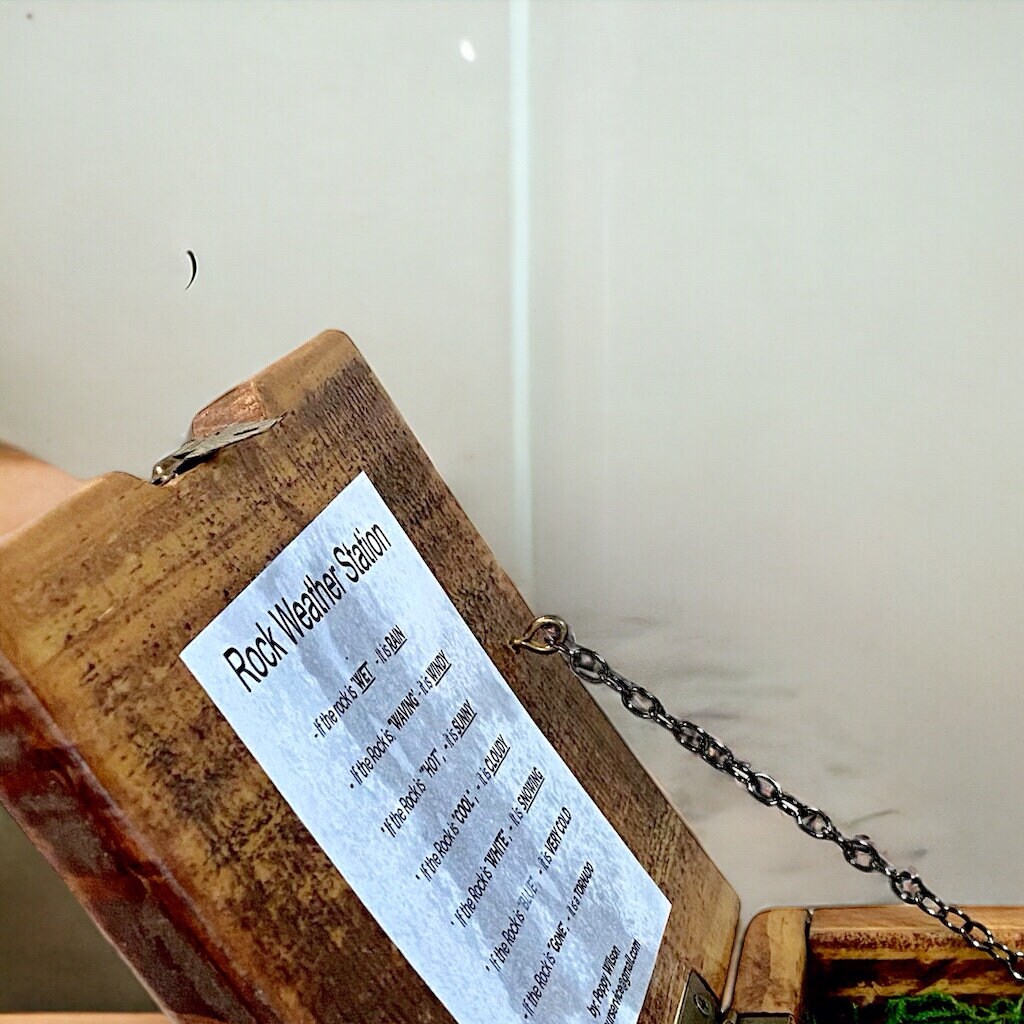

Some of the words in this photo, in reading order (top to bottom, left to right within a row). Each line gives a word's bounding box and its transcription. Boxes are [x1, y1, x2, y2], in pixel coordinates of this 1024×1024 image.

[222, 622, 288, 693] Rock
[267, 565, 347, 645] Weather
[333, 524, 392, 583] Station
[319, 710, 338, 731] the
[333, 690, 353, 718] rock
[384, 624, 408, 656] RAIN
[355, 757, 374, 778] the
[366, 734, 390, 764] Rock
[425, 649, 452, 687] WINDY
[388, 808, 407, 830] the
[399, 785, 422, 815] Rock
[451, 699, 478, 738] SUNNY
[424, 853, 442, 874] the
[433, 829, 456, 859] Rock
[484, 734, 511, 777] CLOUDY
[555, 806, 572, 835] COLD
[459, 897, 476, 919] the
[468, 872, 489, 903] Rock
[517, 766, 545, 814] SNOWING
[544, 826, 562, 855] VERY
[573, 861, 594, 899] TORNADO
[493, 942, 510, 964] the
[501, 916, 522, 947] Rock
[526, 985, 542, 1008] the
[533, 960, 553, 990] Rock
[592, 972, 612, 1004] Poppy
[602, 945, 621, 976] Wilson
